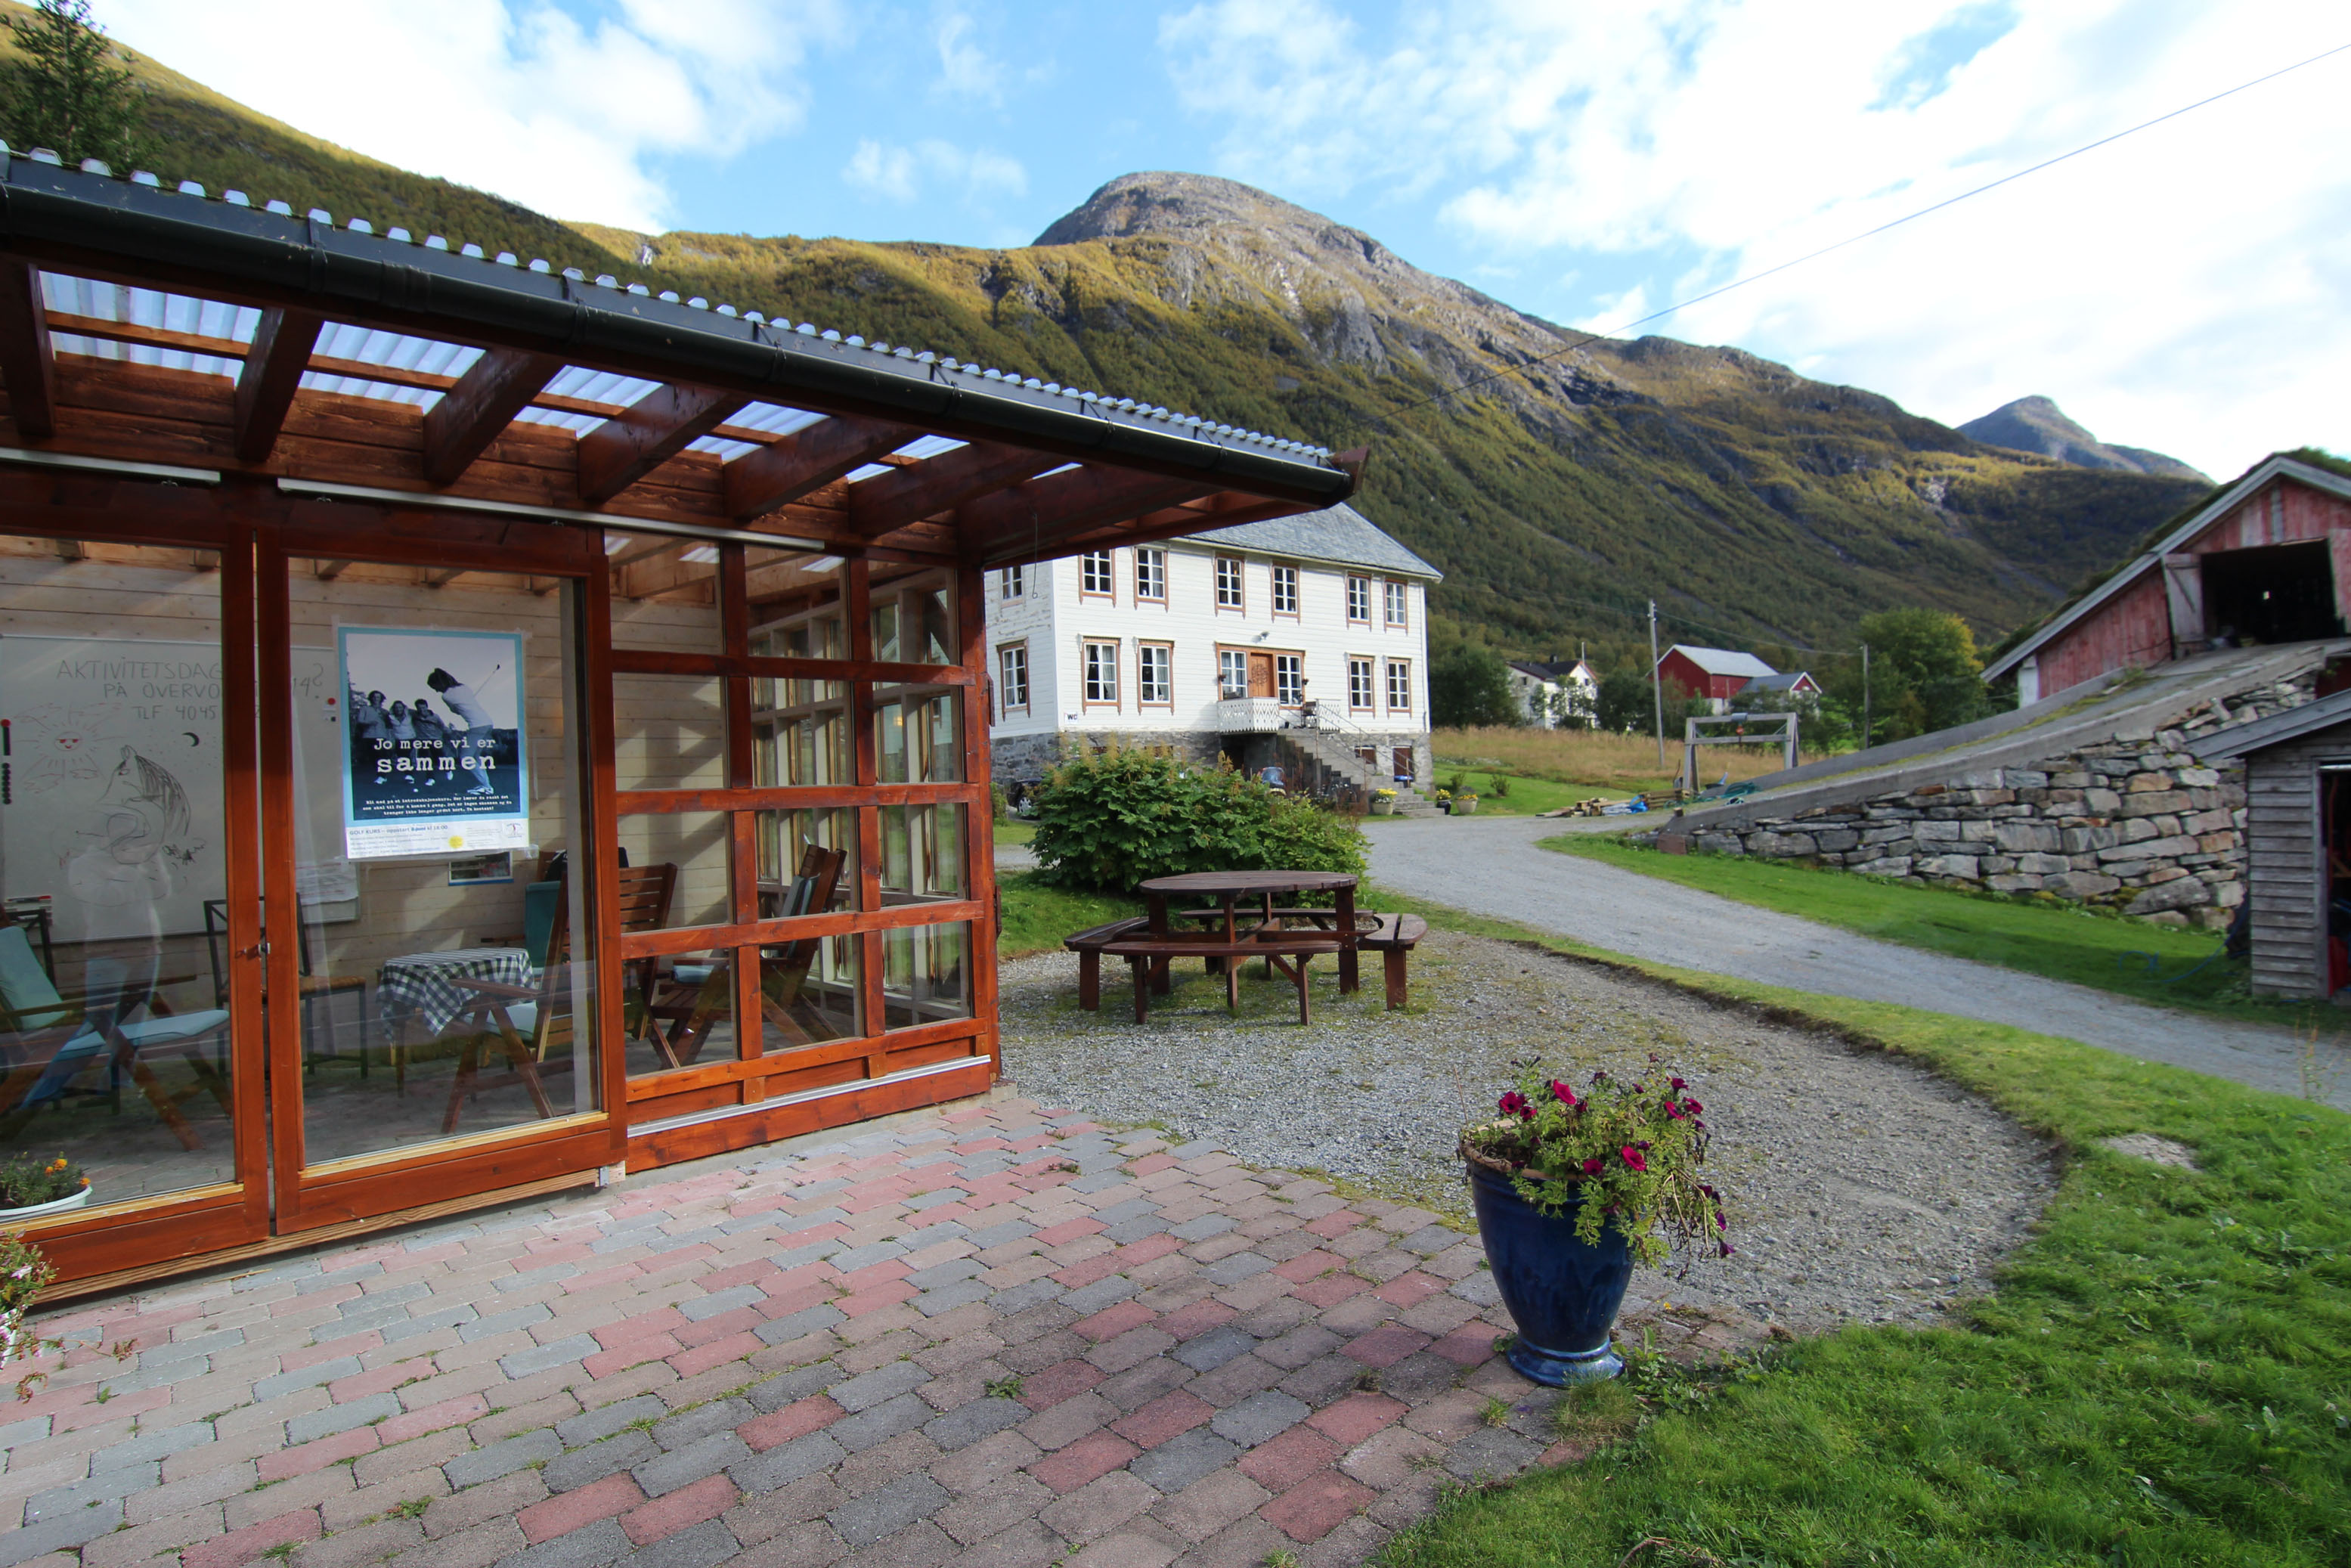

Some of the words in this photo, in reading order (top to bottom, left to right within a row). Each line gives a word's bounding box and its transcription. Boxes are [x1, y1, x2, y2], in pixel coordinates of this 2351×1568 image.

[131, 704, 163, 720] TLF
[373, 738, 392, 750] Jo
[400, 739, 443, 749] mere
[450, 736, 470, 748] vi
[477, 739, 496, 748] er
[377, 755, 496, 773] sammen
